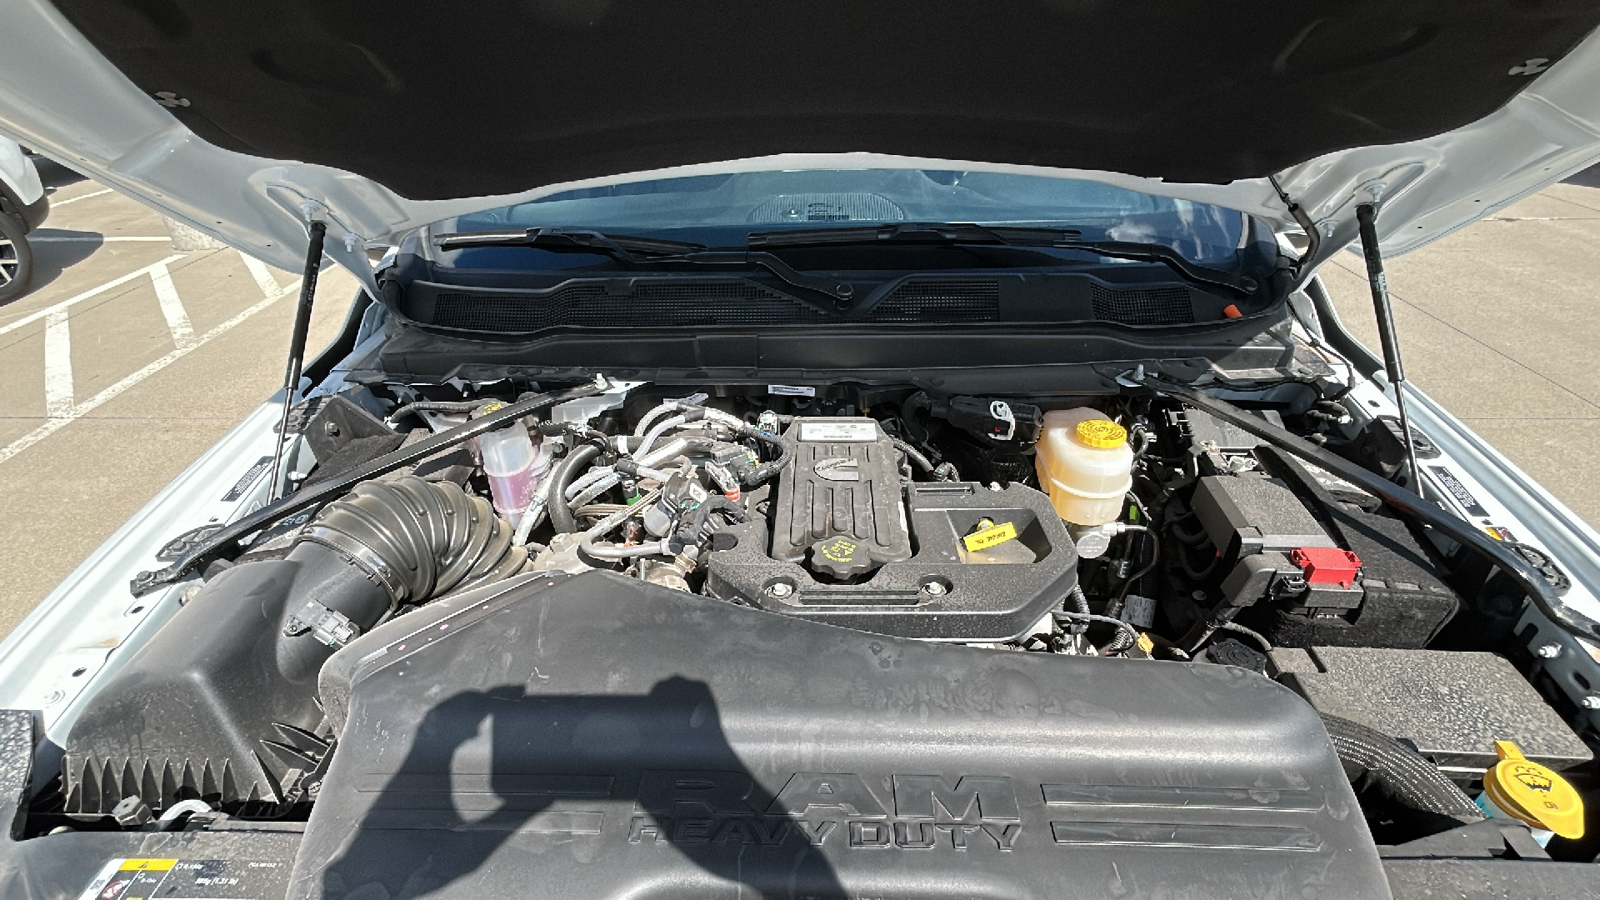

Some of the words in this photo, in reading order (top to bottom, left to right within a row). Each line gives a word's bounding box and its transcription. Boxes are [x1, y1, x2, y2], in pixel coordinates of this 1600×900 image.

[634, 770, 1021, 821] RAM
[628, 817, 838, 846] HEAVY
[849, 820, 1022, 851] DUTY
